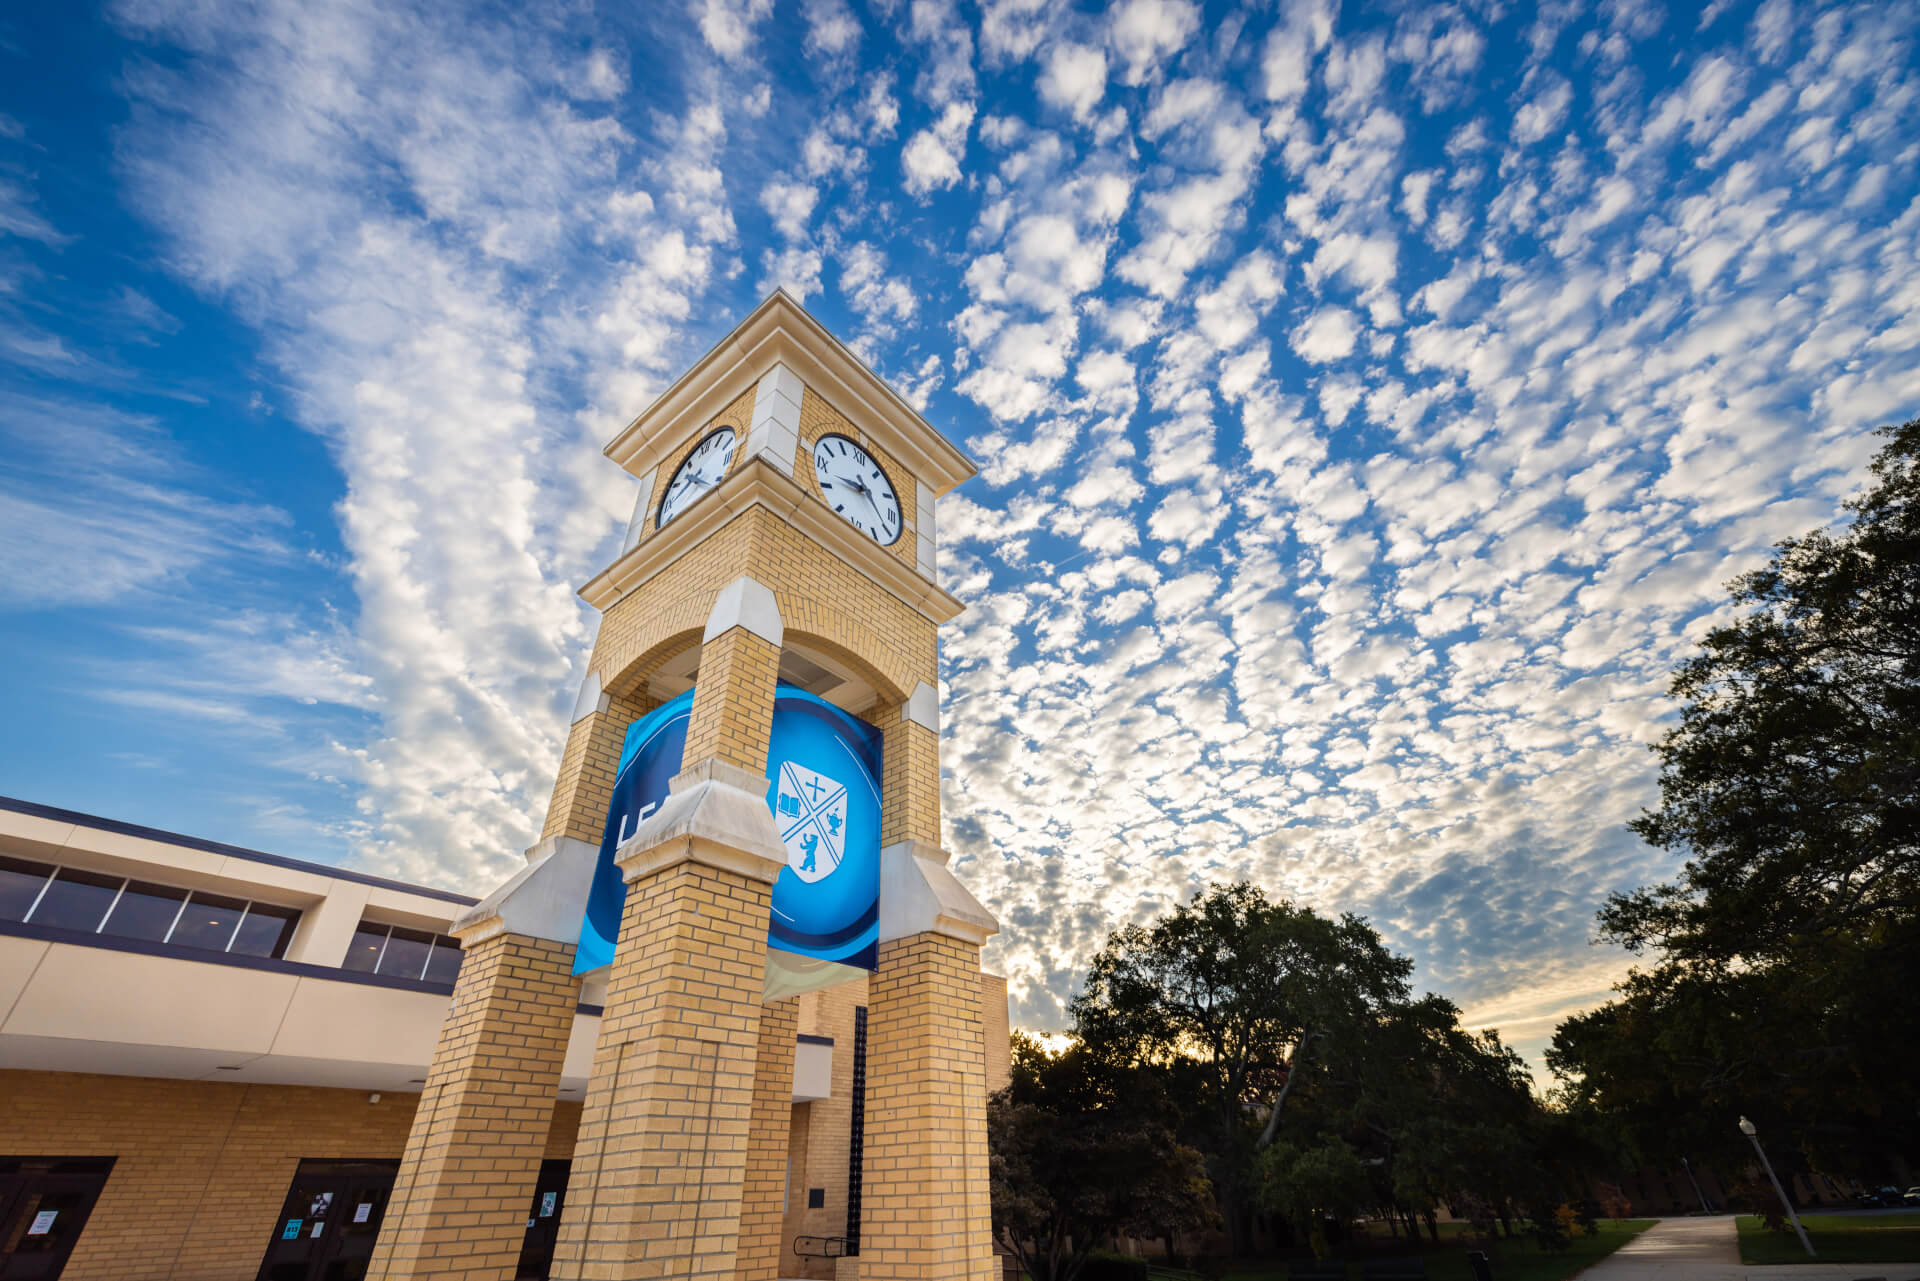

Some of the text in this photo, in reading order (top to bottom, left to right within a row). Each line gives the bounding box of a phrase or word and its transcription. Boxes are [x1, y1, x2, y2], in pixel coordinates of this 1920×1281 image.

[817, 454, 829, 474] IX
[853, 447, 866, 467] XII
[887, 508, 896, 525] III
[616, 794, 671, 850] LE
